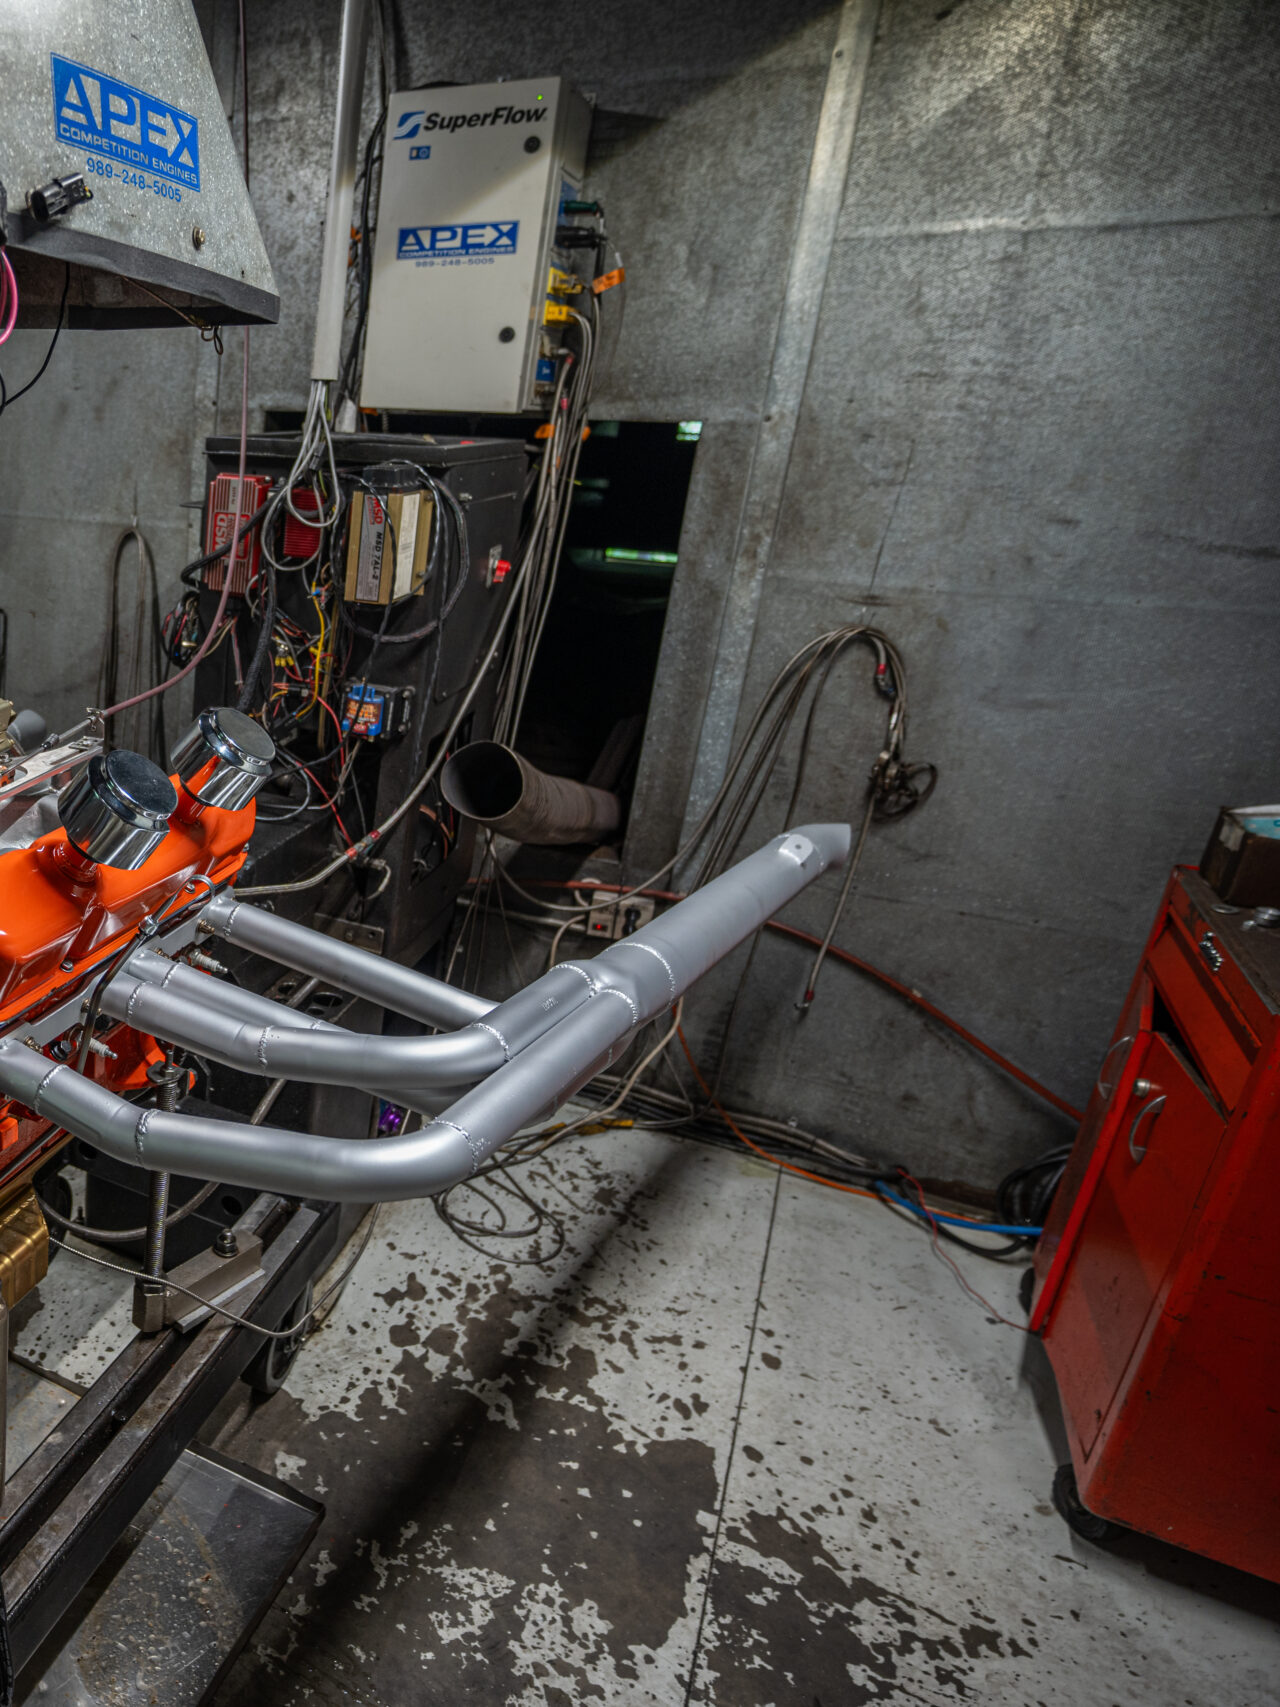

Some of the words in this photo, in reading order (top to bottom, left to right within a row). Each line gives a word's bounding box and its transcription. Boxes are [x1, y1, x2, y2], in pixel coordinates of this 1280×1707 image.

[58, 70, 196, 168] APEX
[423, 106, 548, 134] SuperFlow
[59, 123, 150, 165] COMPETITION
[152, 157, 198, 185] ENGINES
[86, 157, 182, 202] 989-248-5005
[400, 223, 515, 251] APEX
[399, 249, 466, 258] COMPETITION
[415, 257, 495, 268] 989-248-5005
[375, 531, 384, 552] MSD
